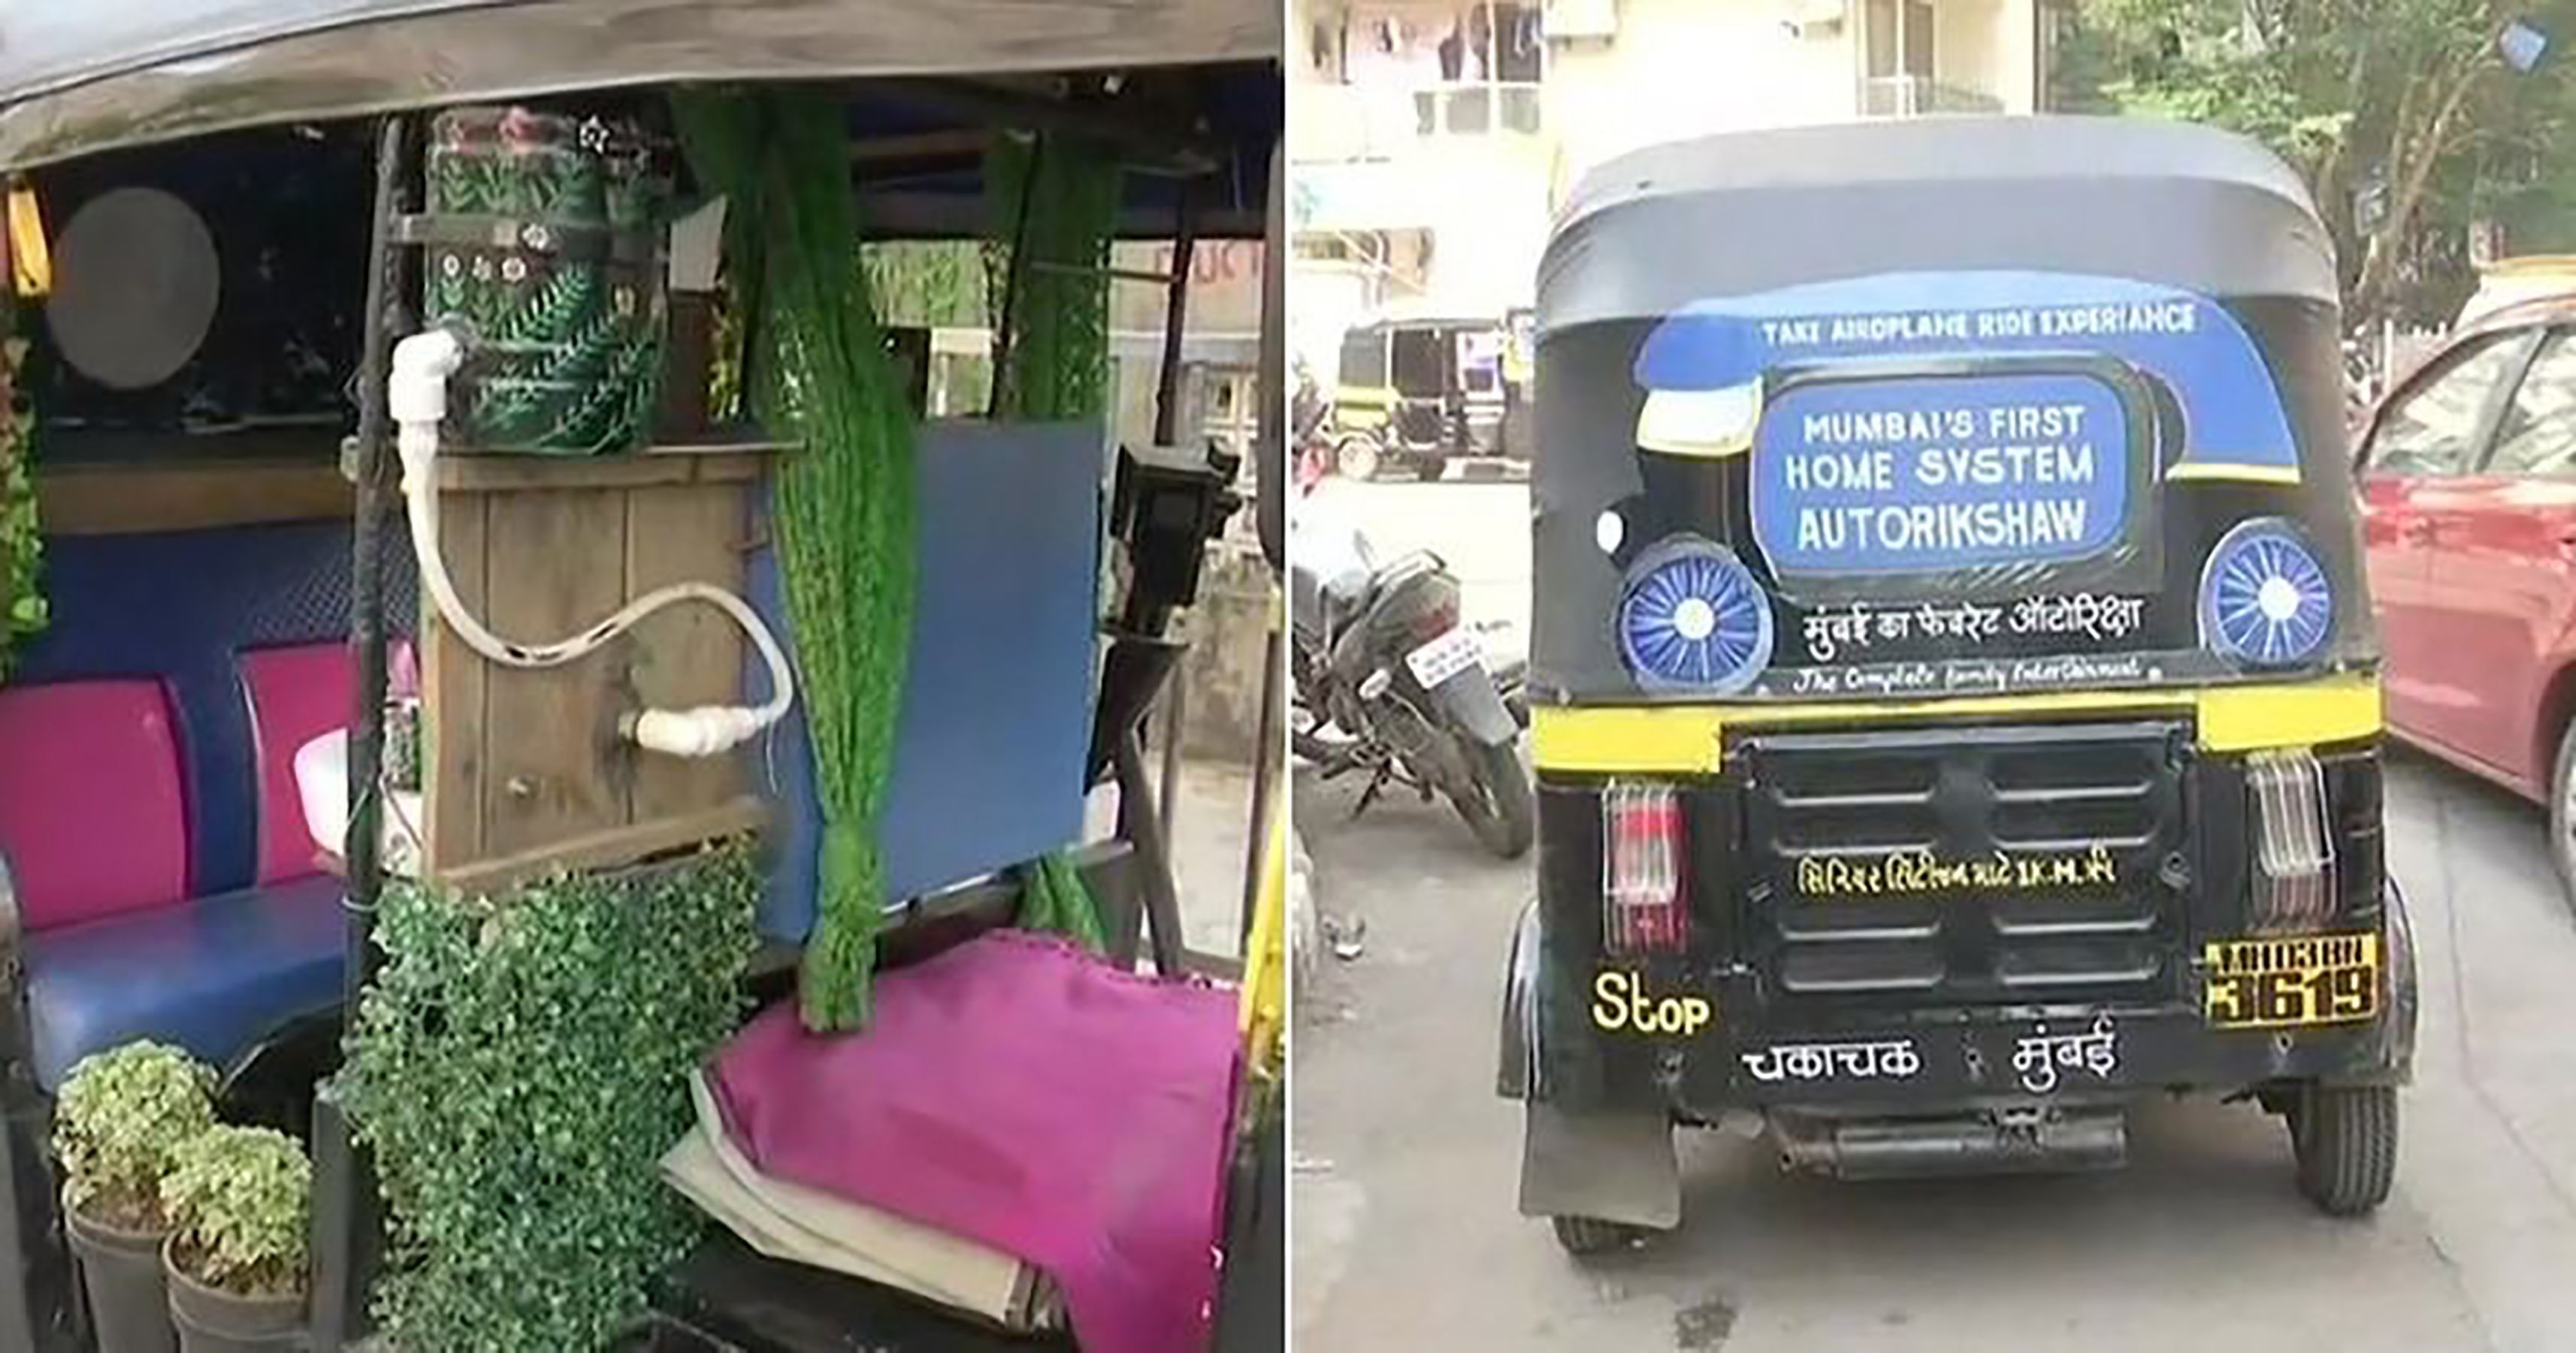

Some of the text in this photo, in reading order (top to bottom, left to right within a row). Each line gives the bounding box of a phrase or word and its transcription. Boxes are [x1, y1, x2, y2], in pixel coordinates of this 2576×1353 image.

[1763, 319, 1819, 345] TAKE
[1979, 310, 2034, 336] RIDE
[1804, 406, 2085, 442] MUMBAI'S FIRST
[1785, 443, 2094, 489] HOME SYSTEM
[1798, 499, 2086, 551] AUTORIKSHAW
[1877, 612, 1911, 639] का
[1593, 973, 1710, 1034] Stop
[2213, 965, 2372, 1021] 3619
[1742, 1012, 2115, 1092] चकाचक मुंबई
